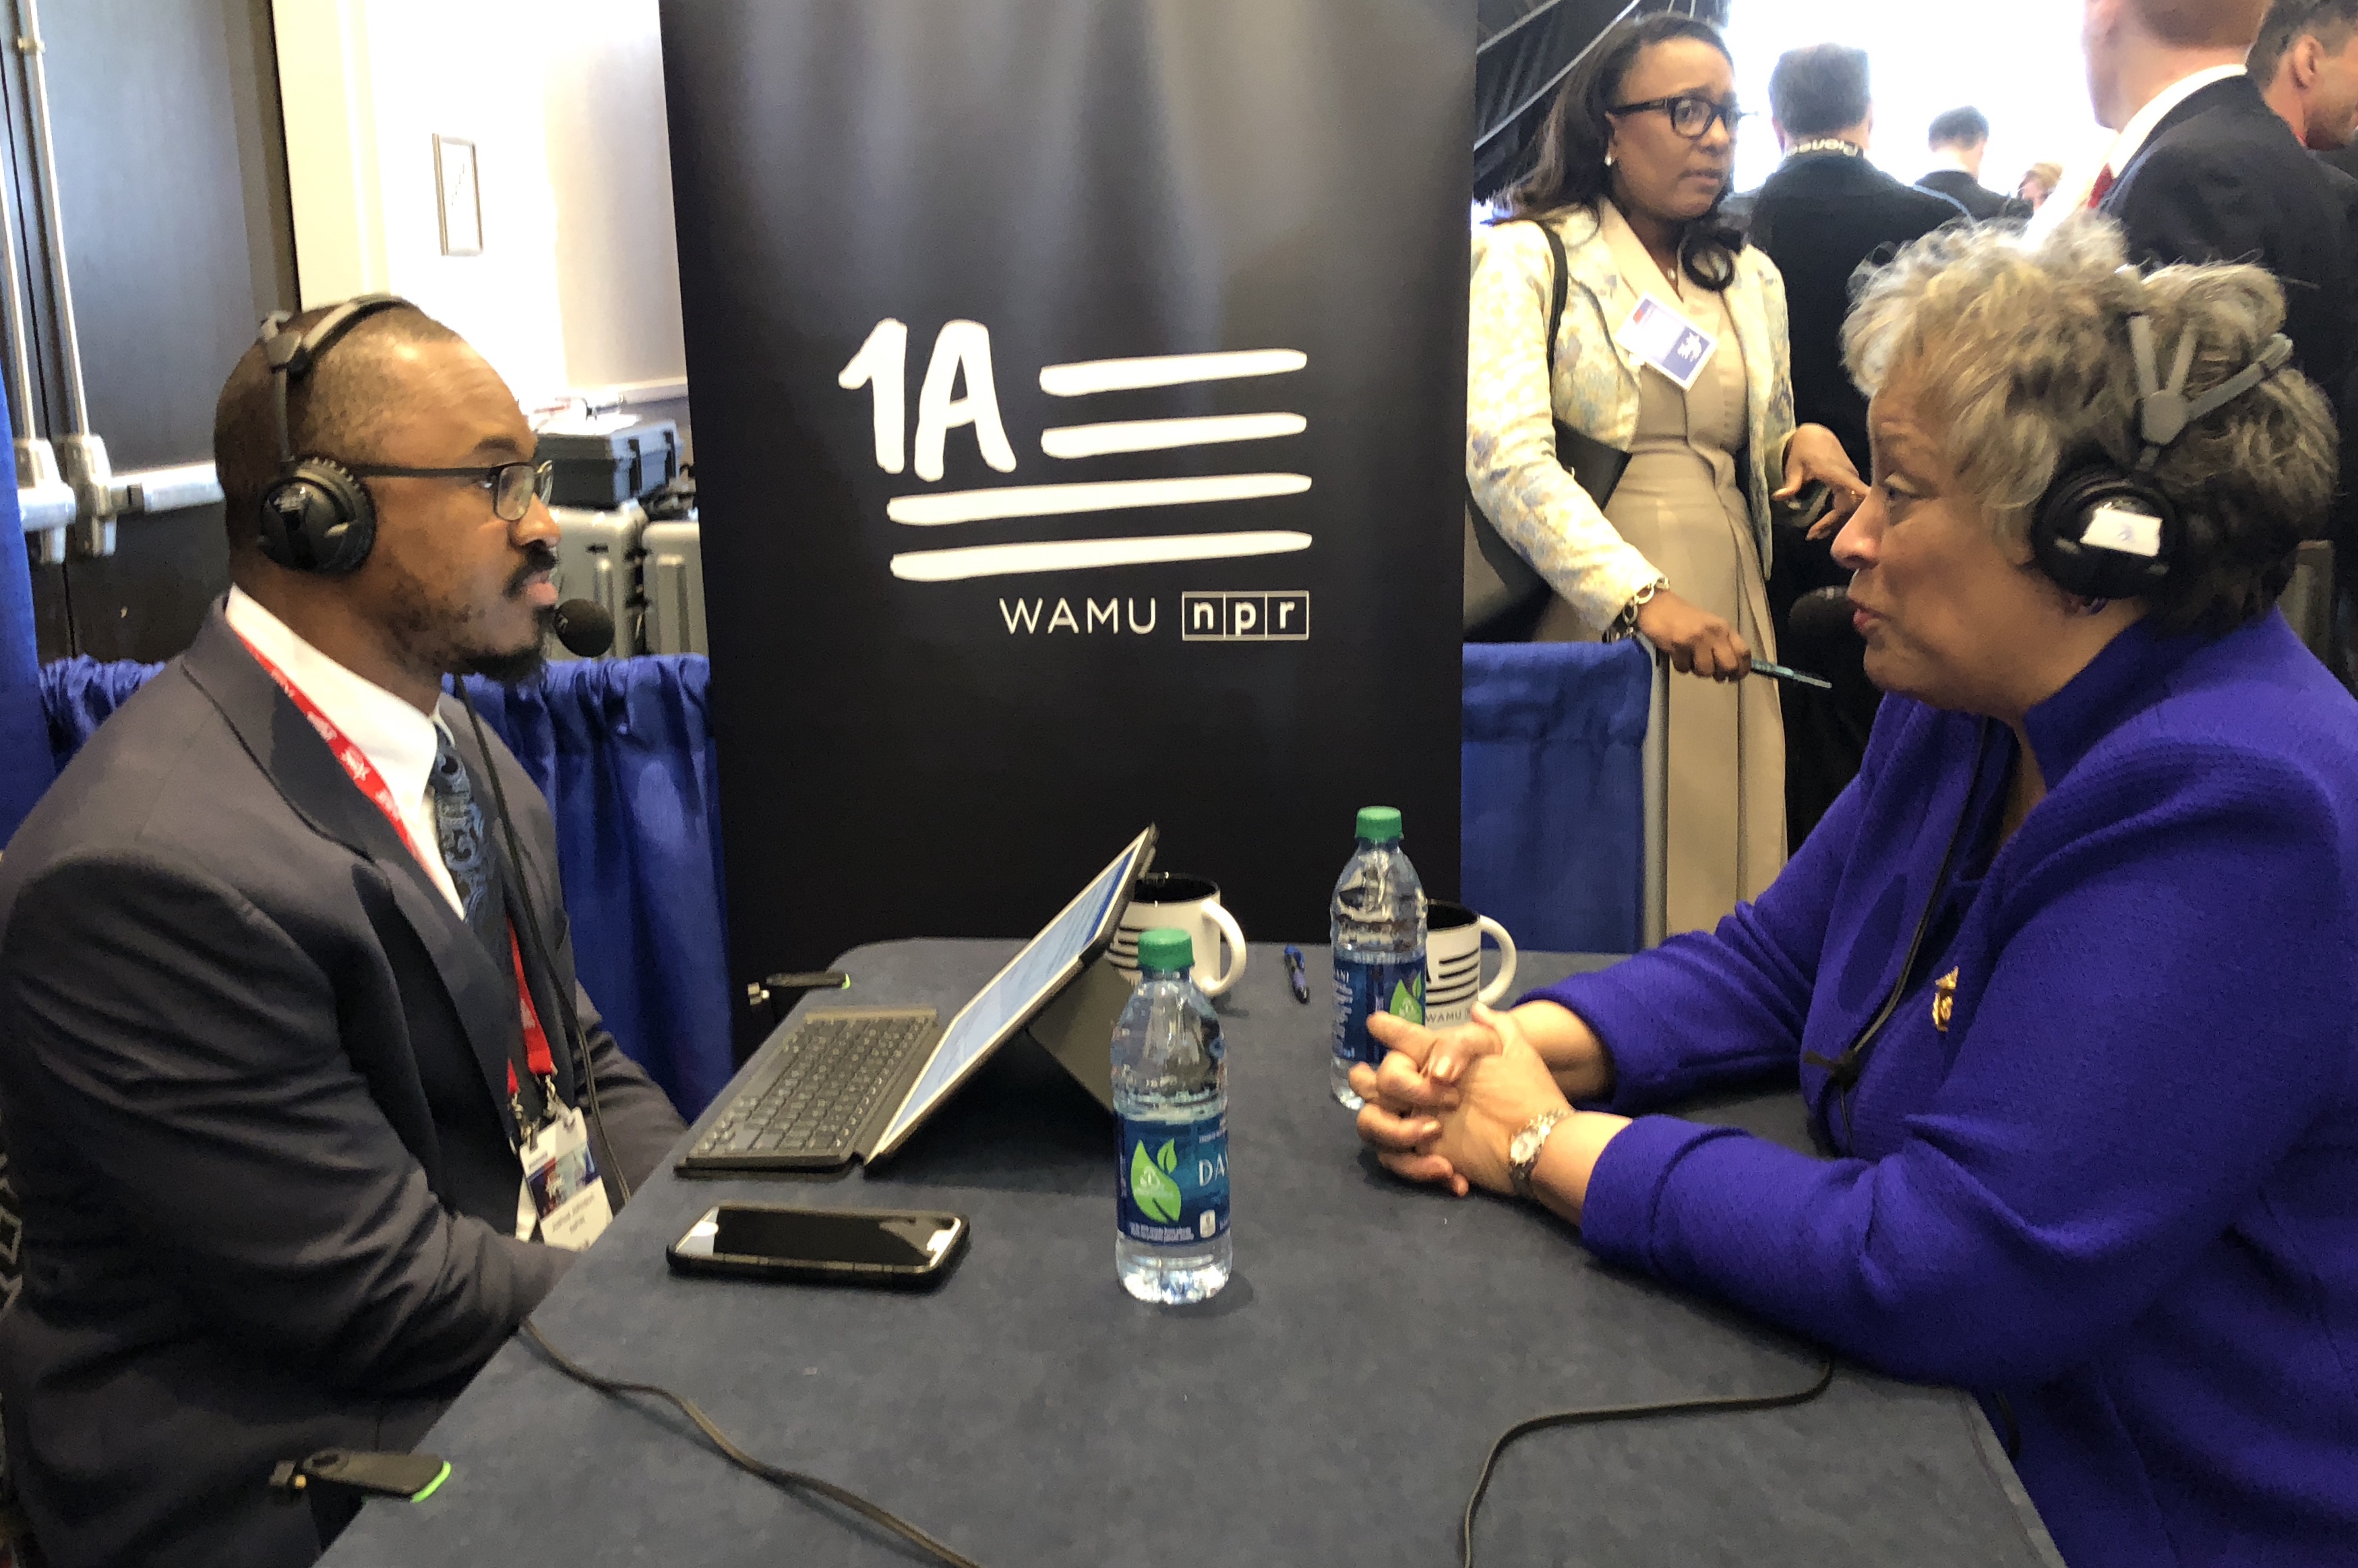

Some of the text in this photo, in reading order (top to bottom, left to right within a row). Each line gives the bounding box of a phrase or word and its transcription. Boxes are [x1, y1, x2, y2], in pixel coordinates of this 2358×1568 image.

[838, 318, 1017, 481] 1A
[999, 597, 1297, 638] WAMU npr
[1426, 1010, 1462, 1023] WAMU
